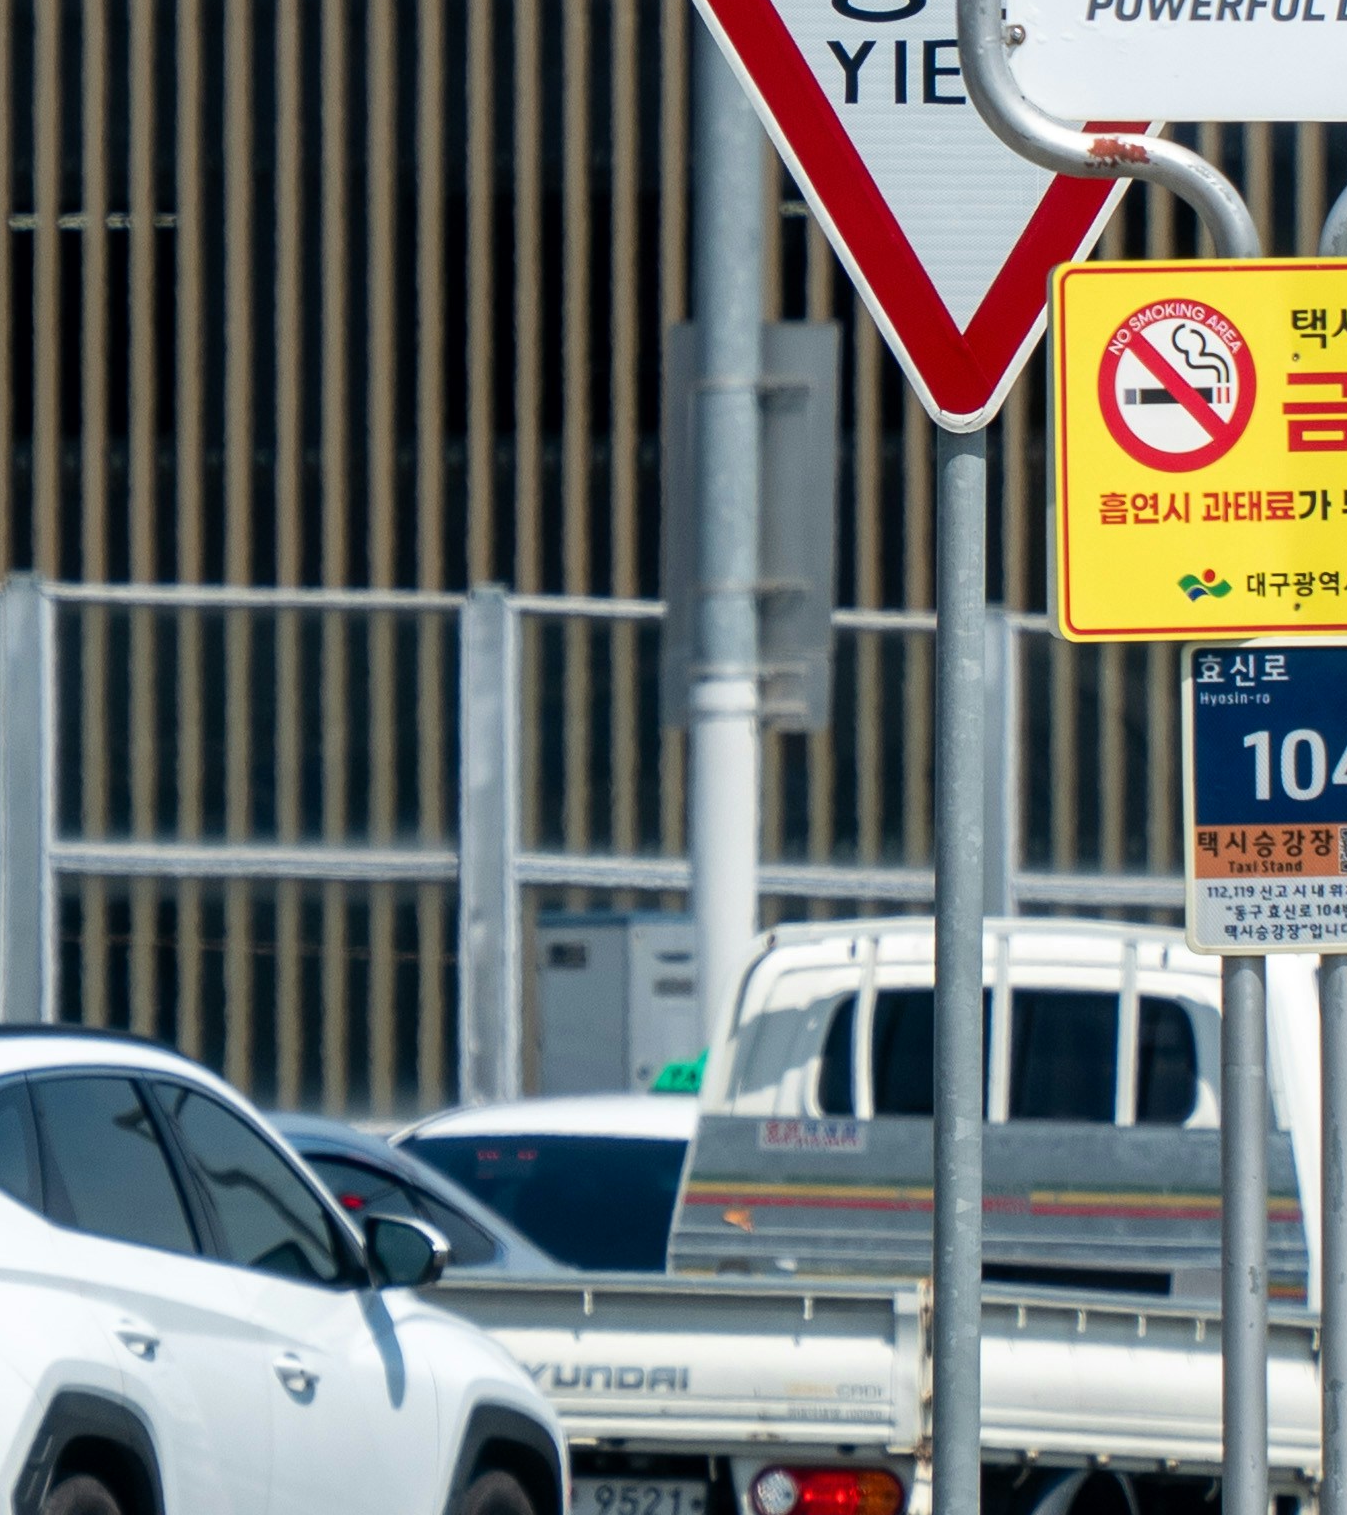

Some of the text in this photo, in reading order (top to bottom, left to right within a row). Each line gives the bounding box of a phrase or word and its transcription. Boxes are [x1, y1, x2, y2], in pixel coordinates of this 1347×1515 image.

[826, 39, 967, 105] YIE
[1108, 303, 1242, 355] NO SMOKING AREA
[1099, 491, 1191, 525] 흡연시
[1202, 489, 1332, 523] 과태료가
[1196, 654, 1290, 687] 효신로
[1200, 691, 1271, 707] Hyosin-ro
[1198, 829, 1334, 858] 택시승강장
[1228, 860, 1303, 873] Taxi Stand
[1207, 885, 1255, 899] 112,119
[1260, 884, 1288, 900] 신고
[1312, 884, 1325, 898] 내
[1267, 904, 1312, 920] 효신로
[521, 1362, 690, 1391] YUNDAI
